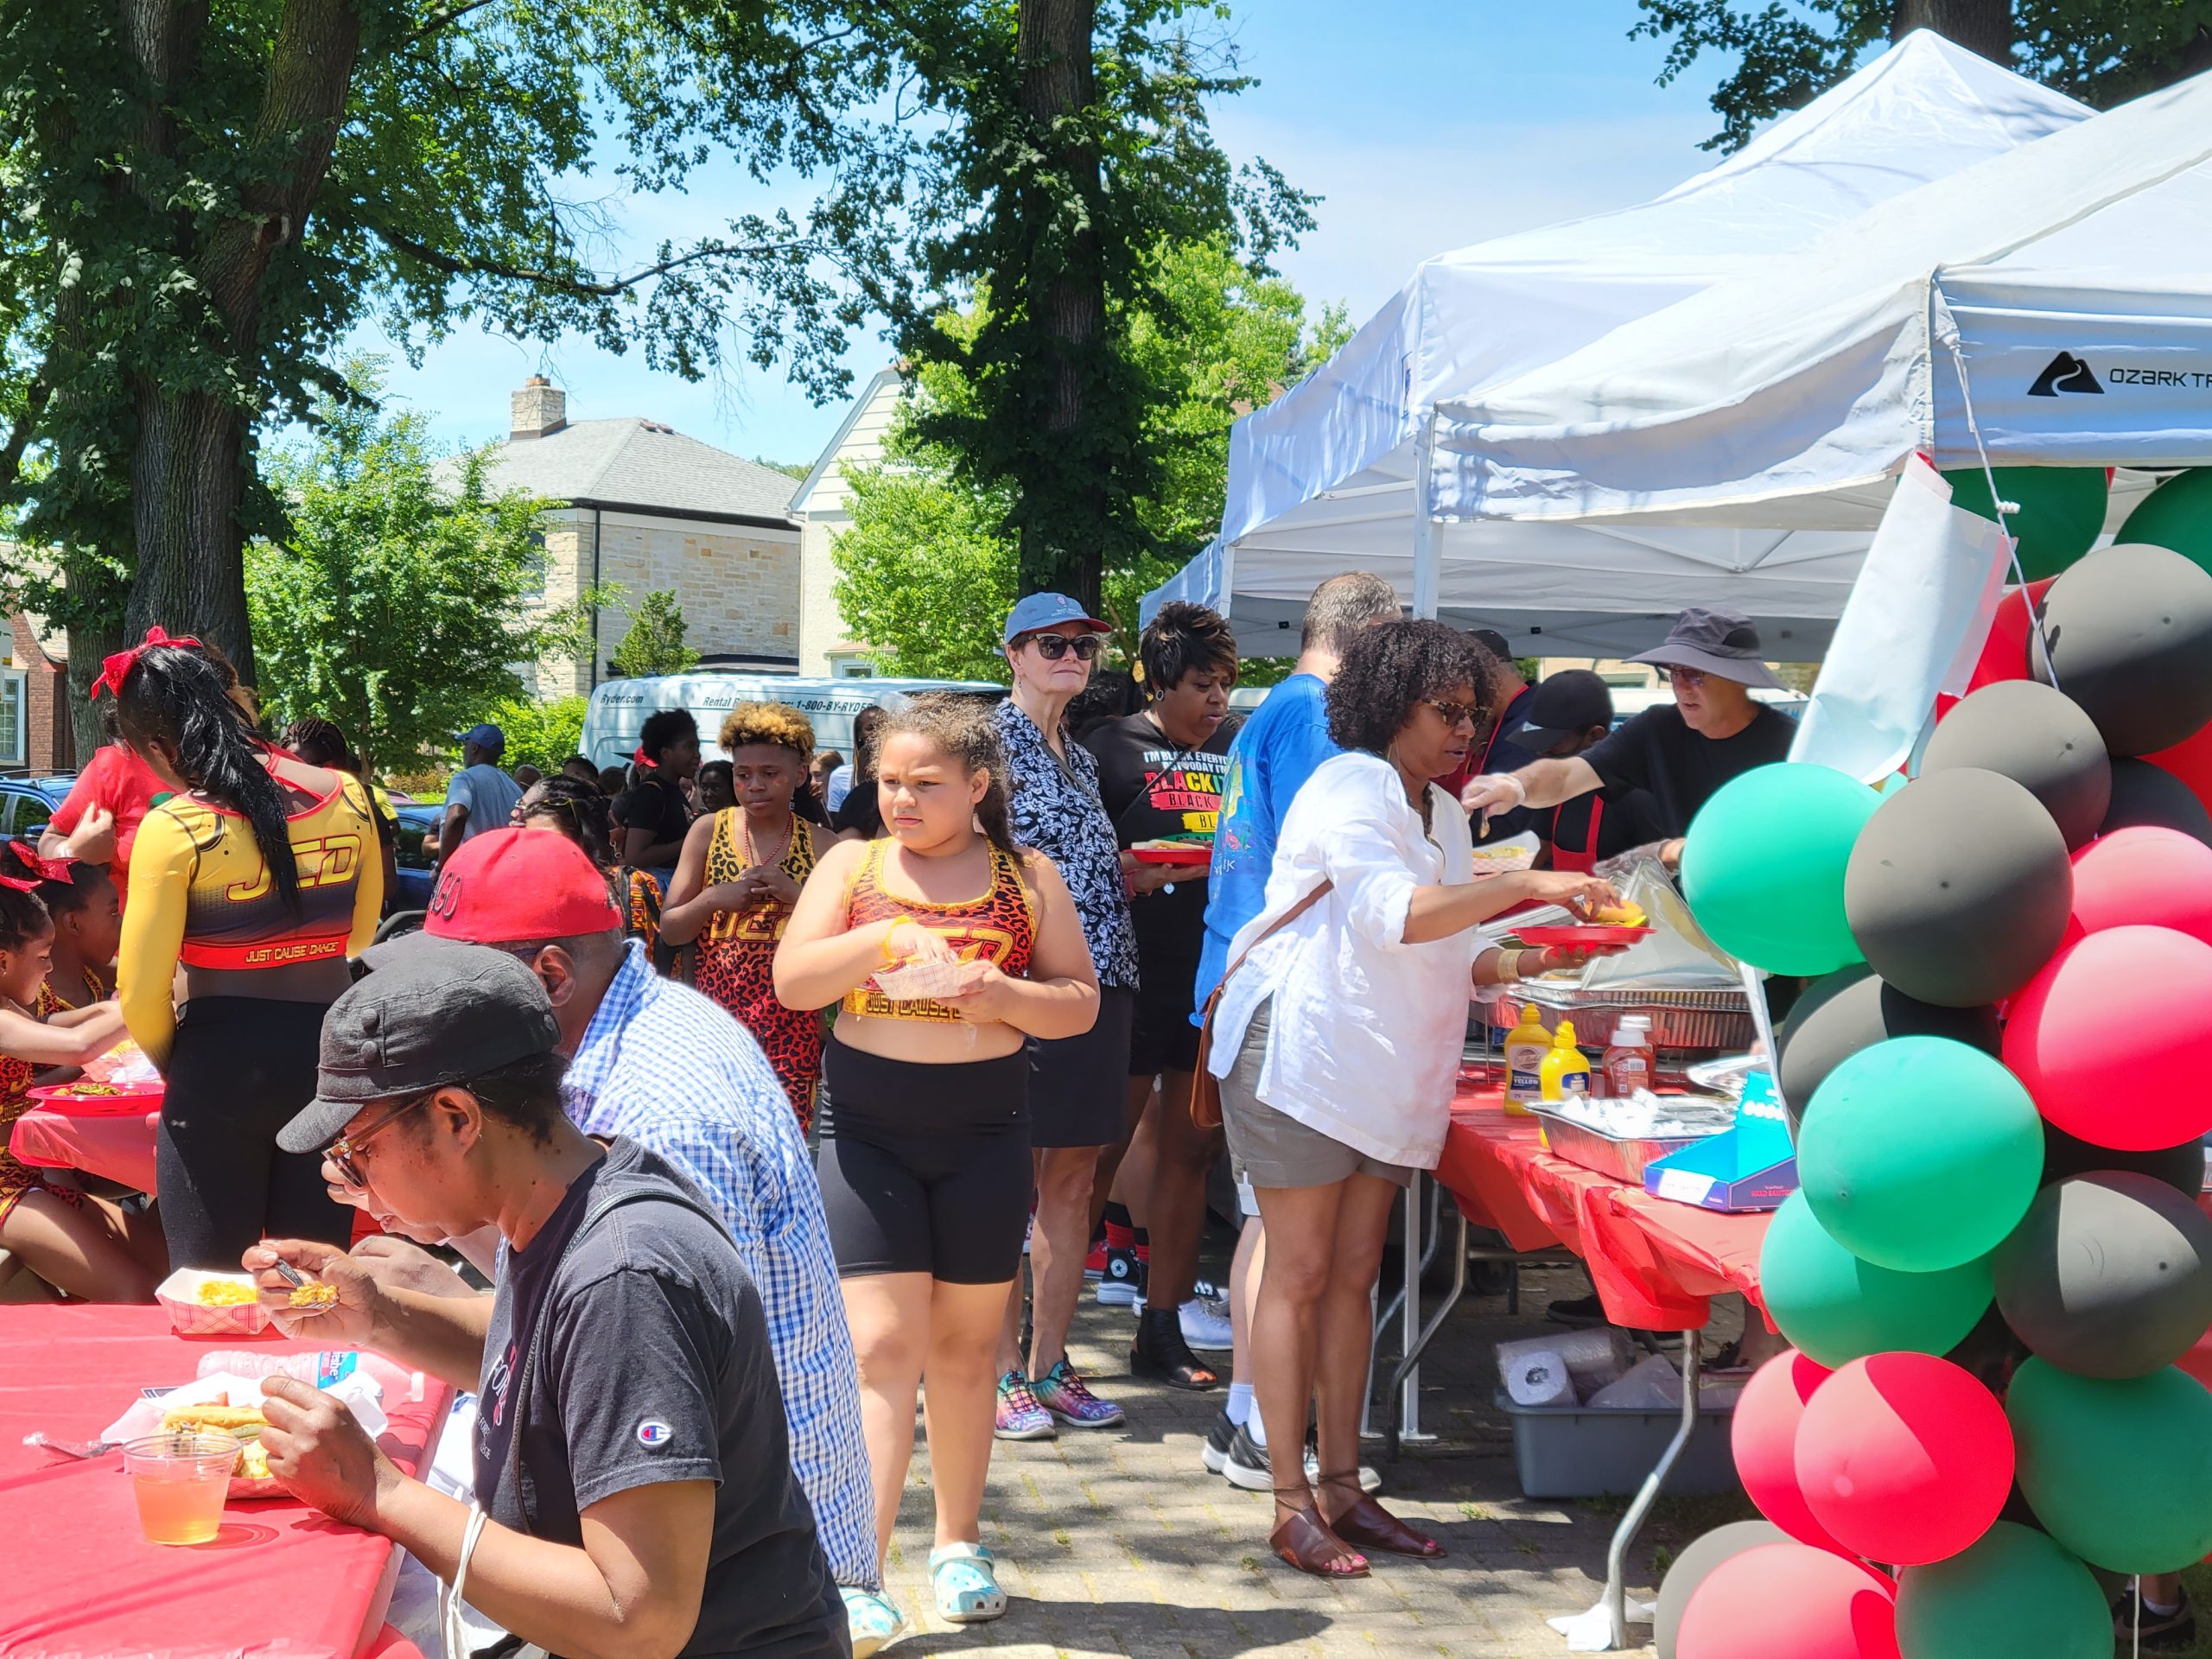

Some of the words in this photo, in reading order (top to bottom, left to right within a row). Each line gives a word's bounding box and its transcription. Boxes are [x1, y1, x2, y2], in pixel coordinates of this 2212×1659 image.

[600, 693, 645, 705] Ryder.com
[702, 696, 731, 707] Rental
[1195, 751, 1228, 765] EVERYD
[1168, 792, 1213, 810] BLACK
[245, 949, 272, 963] JUST
[274, 944, 308, 961] CAUSE
[308, 941, 340, 955] DANCE
